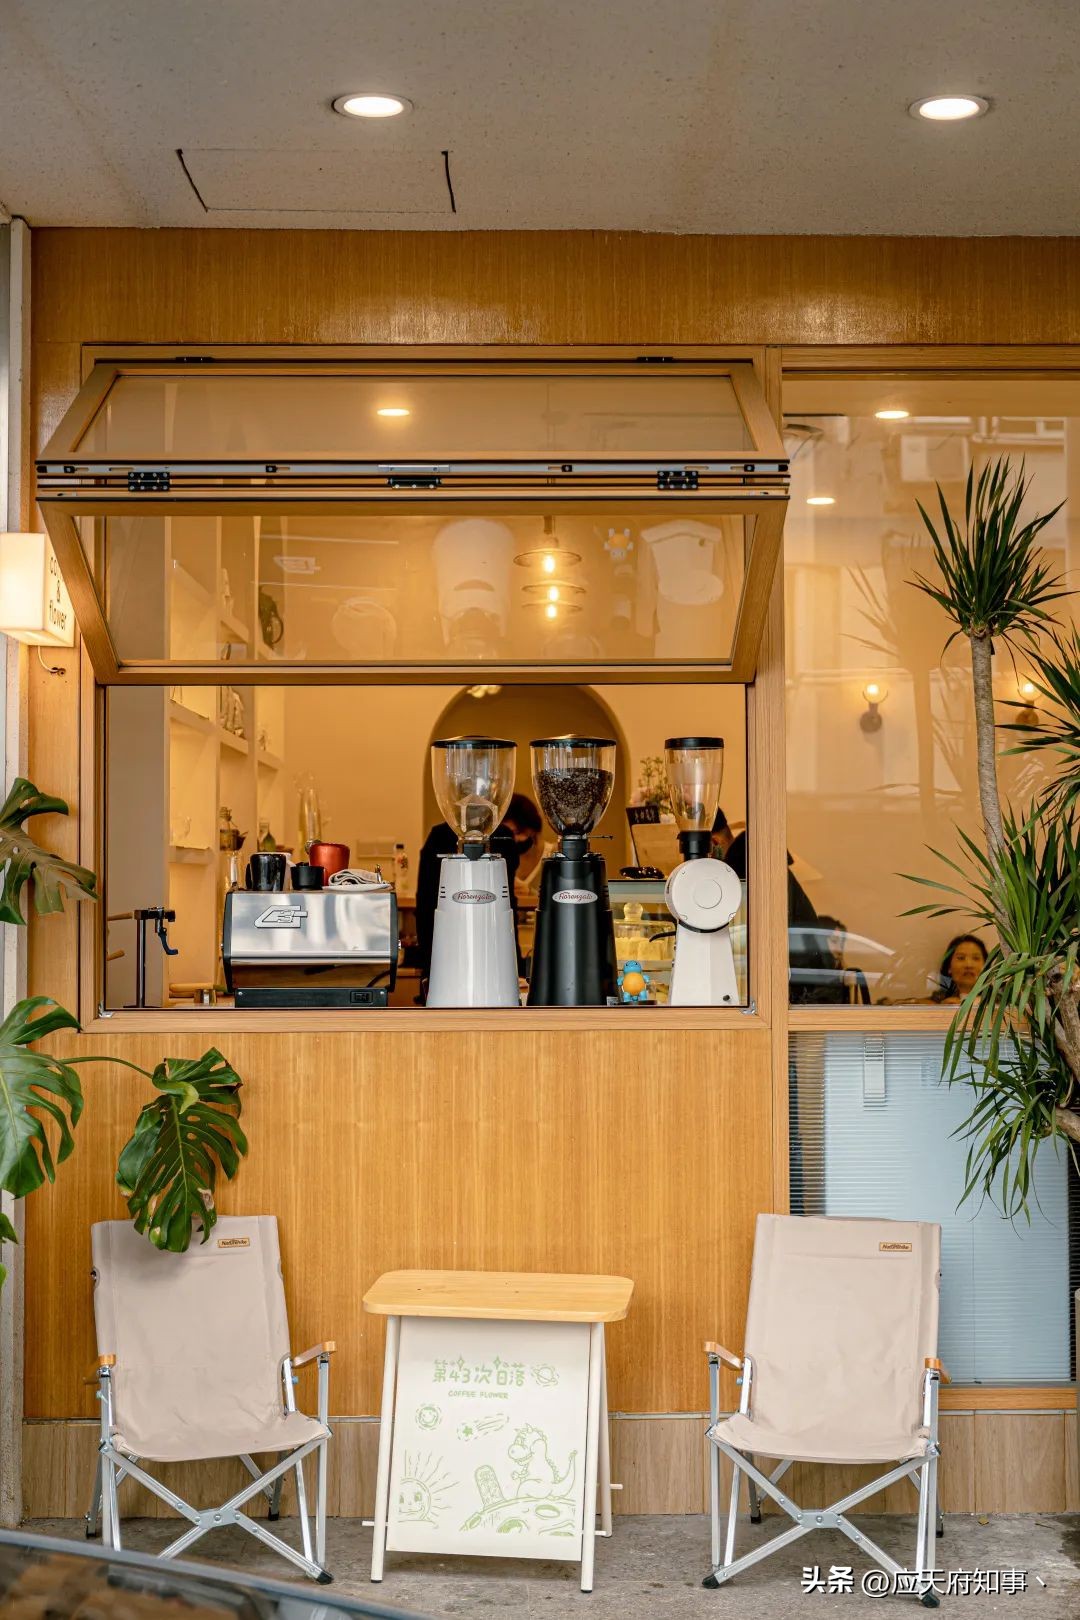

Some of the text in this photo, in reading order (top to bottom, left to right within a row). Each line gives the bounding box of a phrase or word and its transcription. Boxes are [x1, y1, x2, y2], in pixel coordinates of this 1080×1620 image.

[49, 600, 67, 630] flower
[432, 1358, 526, 1387] 第43次日落
[448, 1390, 509, 1399] COFFEE FLOWER
